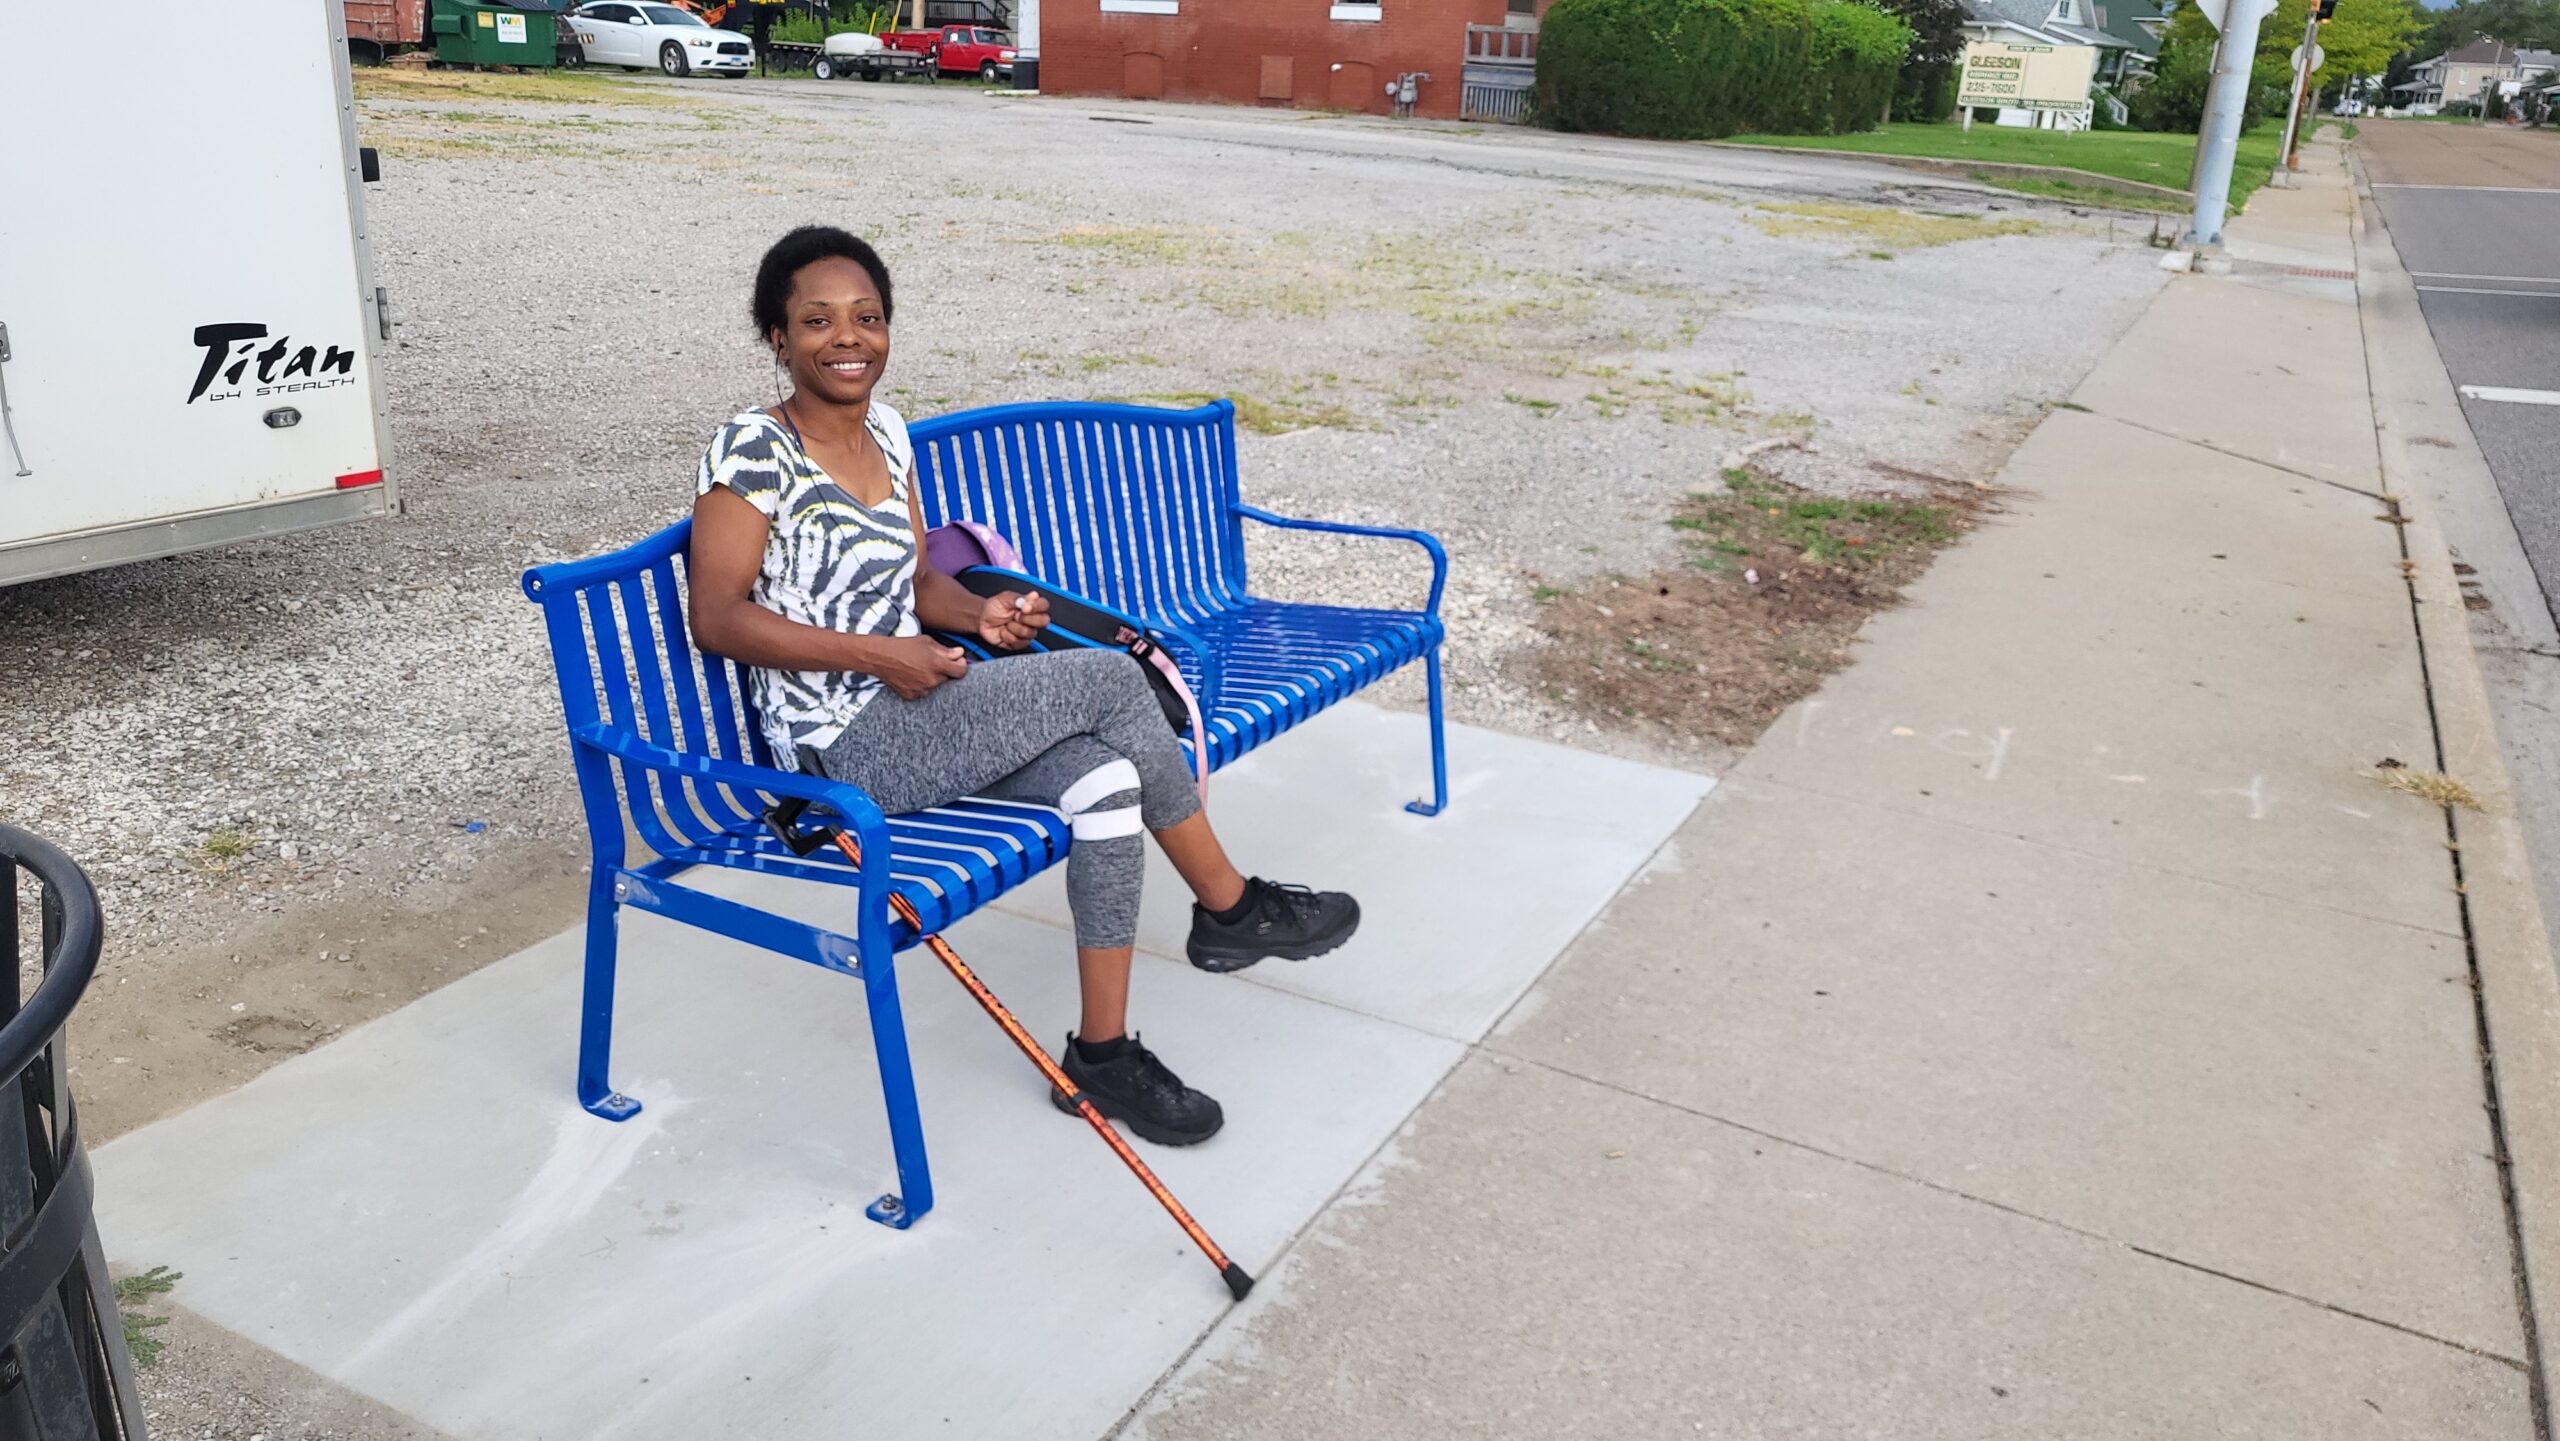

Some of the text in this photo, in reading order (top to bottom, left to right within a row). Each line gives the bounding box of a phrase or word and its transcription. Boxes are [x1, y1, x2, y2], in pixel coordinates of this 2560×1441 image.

[500, 16, 521, 25] WM
[1970, 55, 2021, 69] GLEESON
[187, 323, 355, 404] Titan
[256, 377, 355, 396] STEALTH
